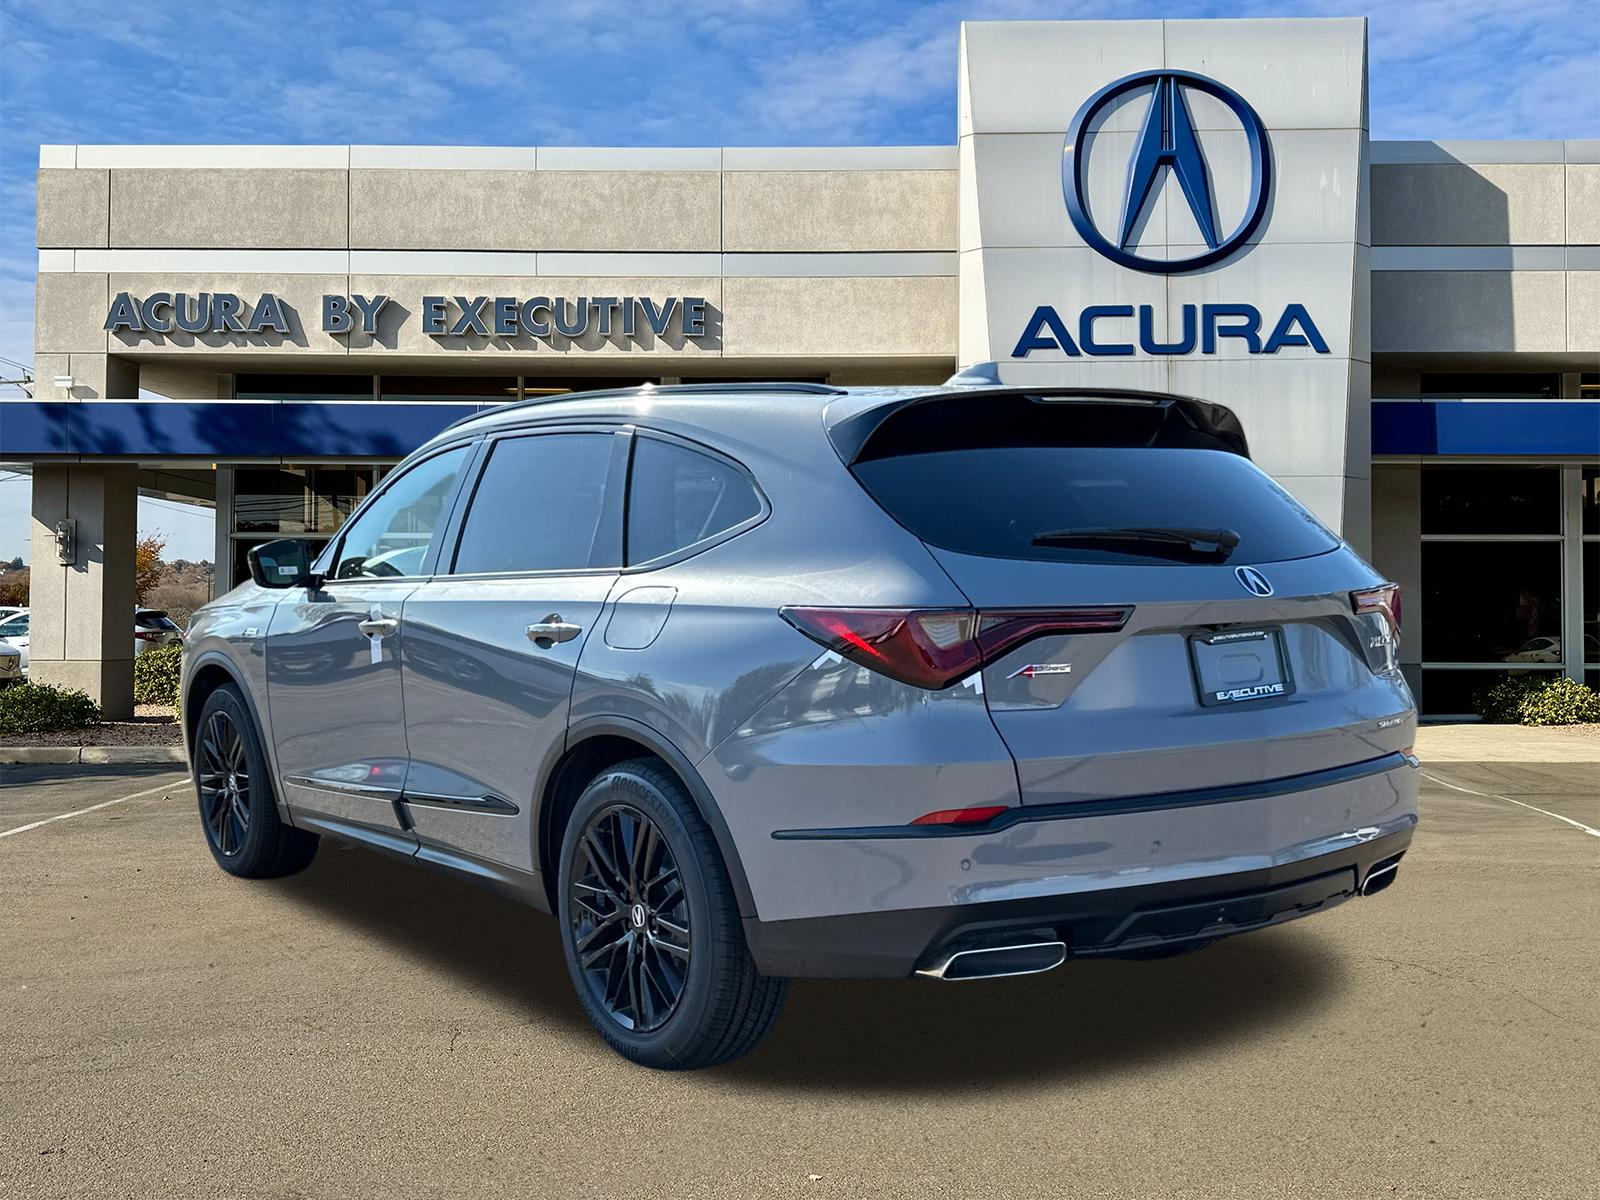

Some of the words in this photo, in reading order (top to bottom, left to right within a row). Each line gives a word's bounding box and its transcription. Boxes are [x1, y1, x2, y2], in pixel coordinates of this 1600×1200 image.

[104, 292, 289, 333] ACURA
[322, 295, 389, 333] BY
[423, 296, 705, 335] EXECUTIVE
[1011, 303, 1331, 356] ACURA
[1216, 683, 1284, 700] EXECUTIVE
